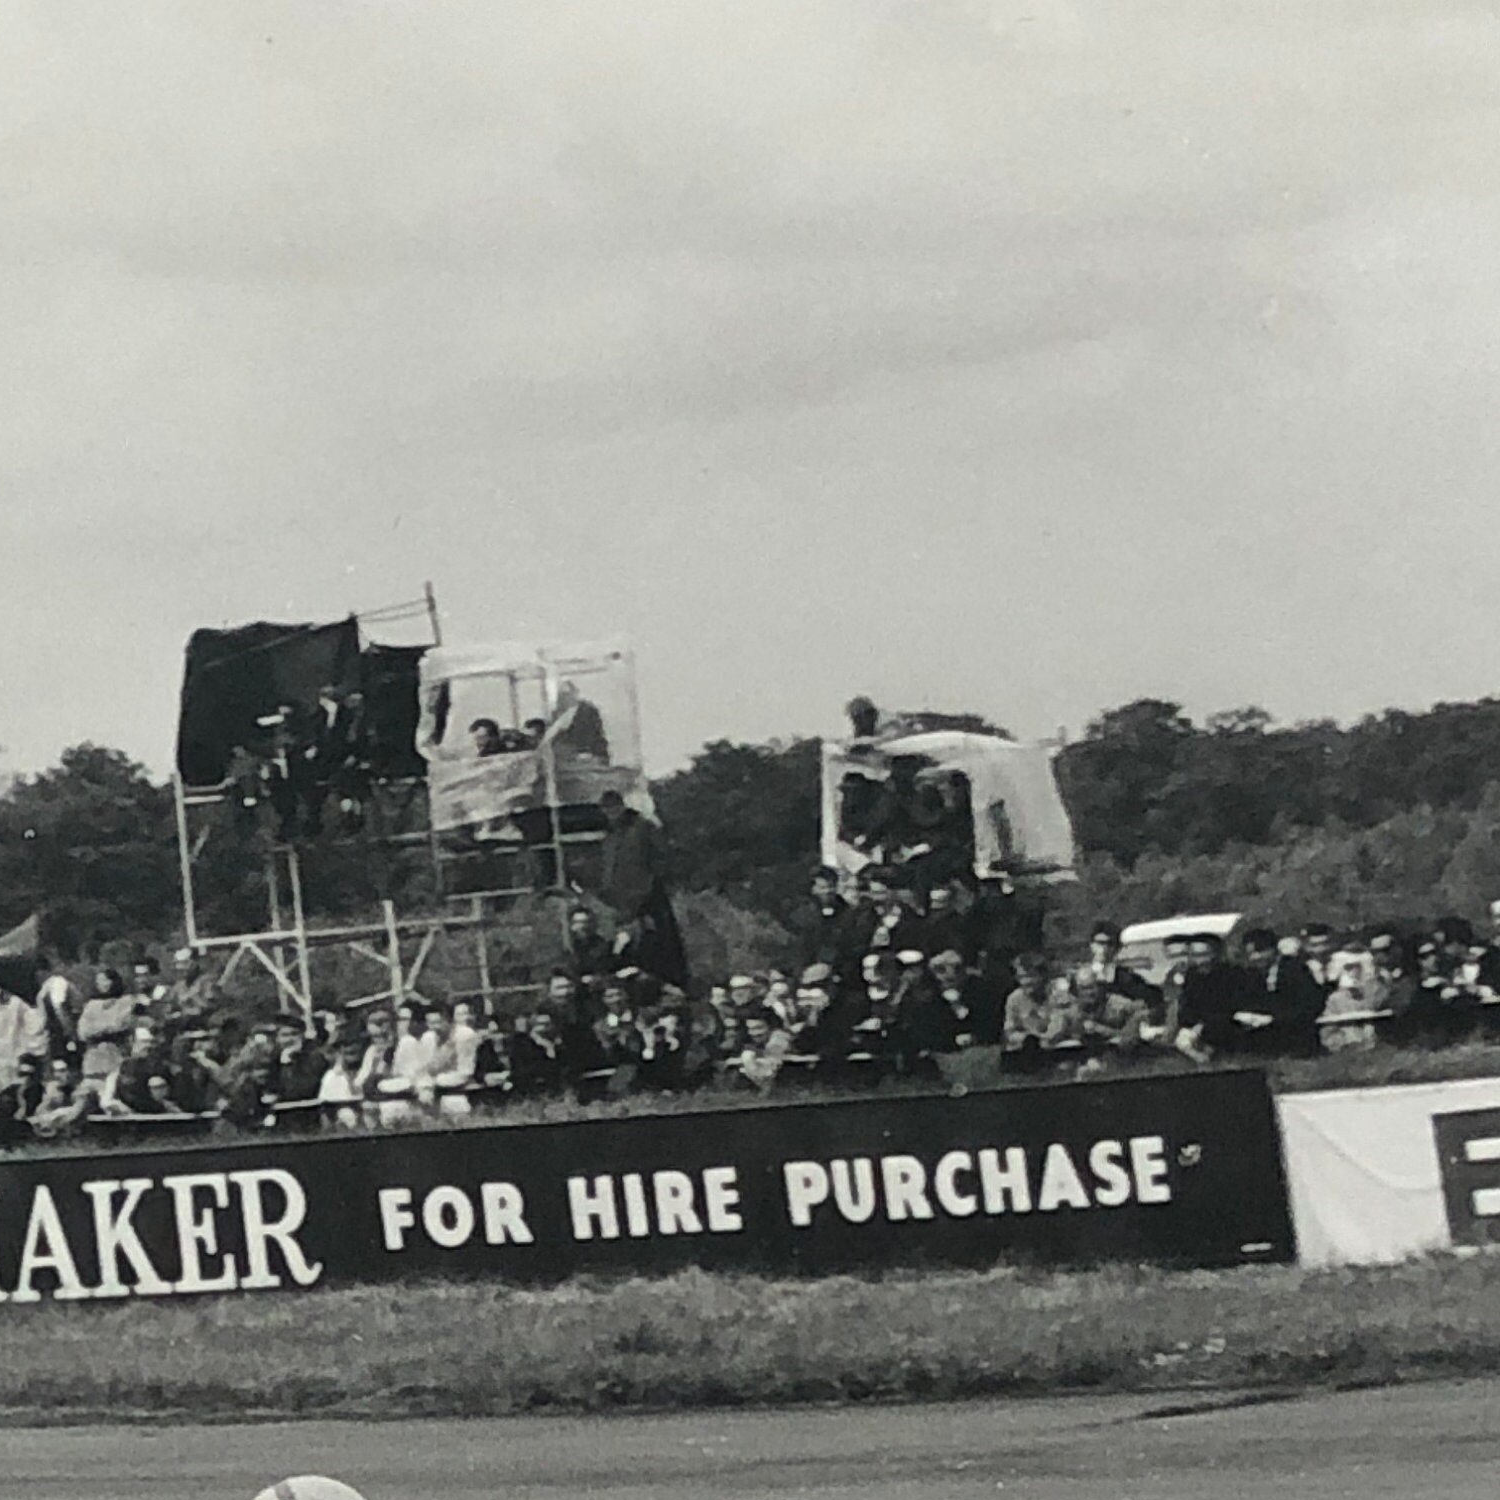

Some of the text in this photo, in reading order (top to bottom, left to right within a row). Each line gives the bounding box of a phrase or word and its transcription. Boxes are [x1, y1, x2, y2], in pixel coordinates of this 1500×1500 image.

[378, 1182, 534, 1250] FOR
[567, 1166, 743, 1241] HIRE
[783, 1135, 1171, 1227] PURCHASE
